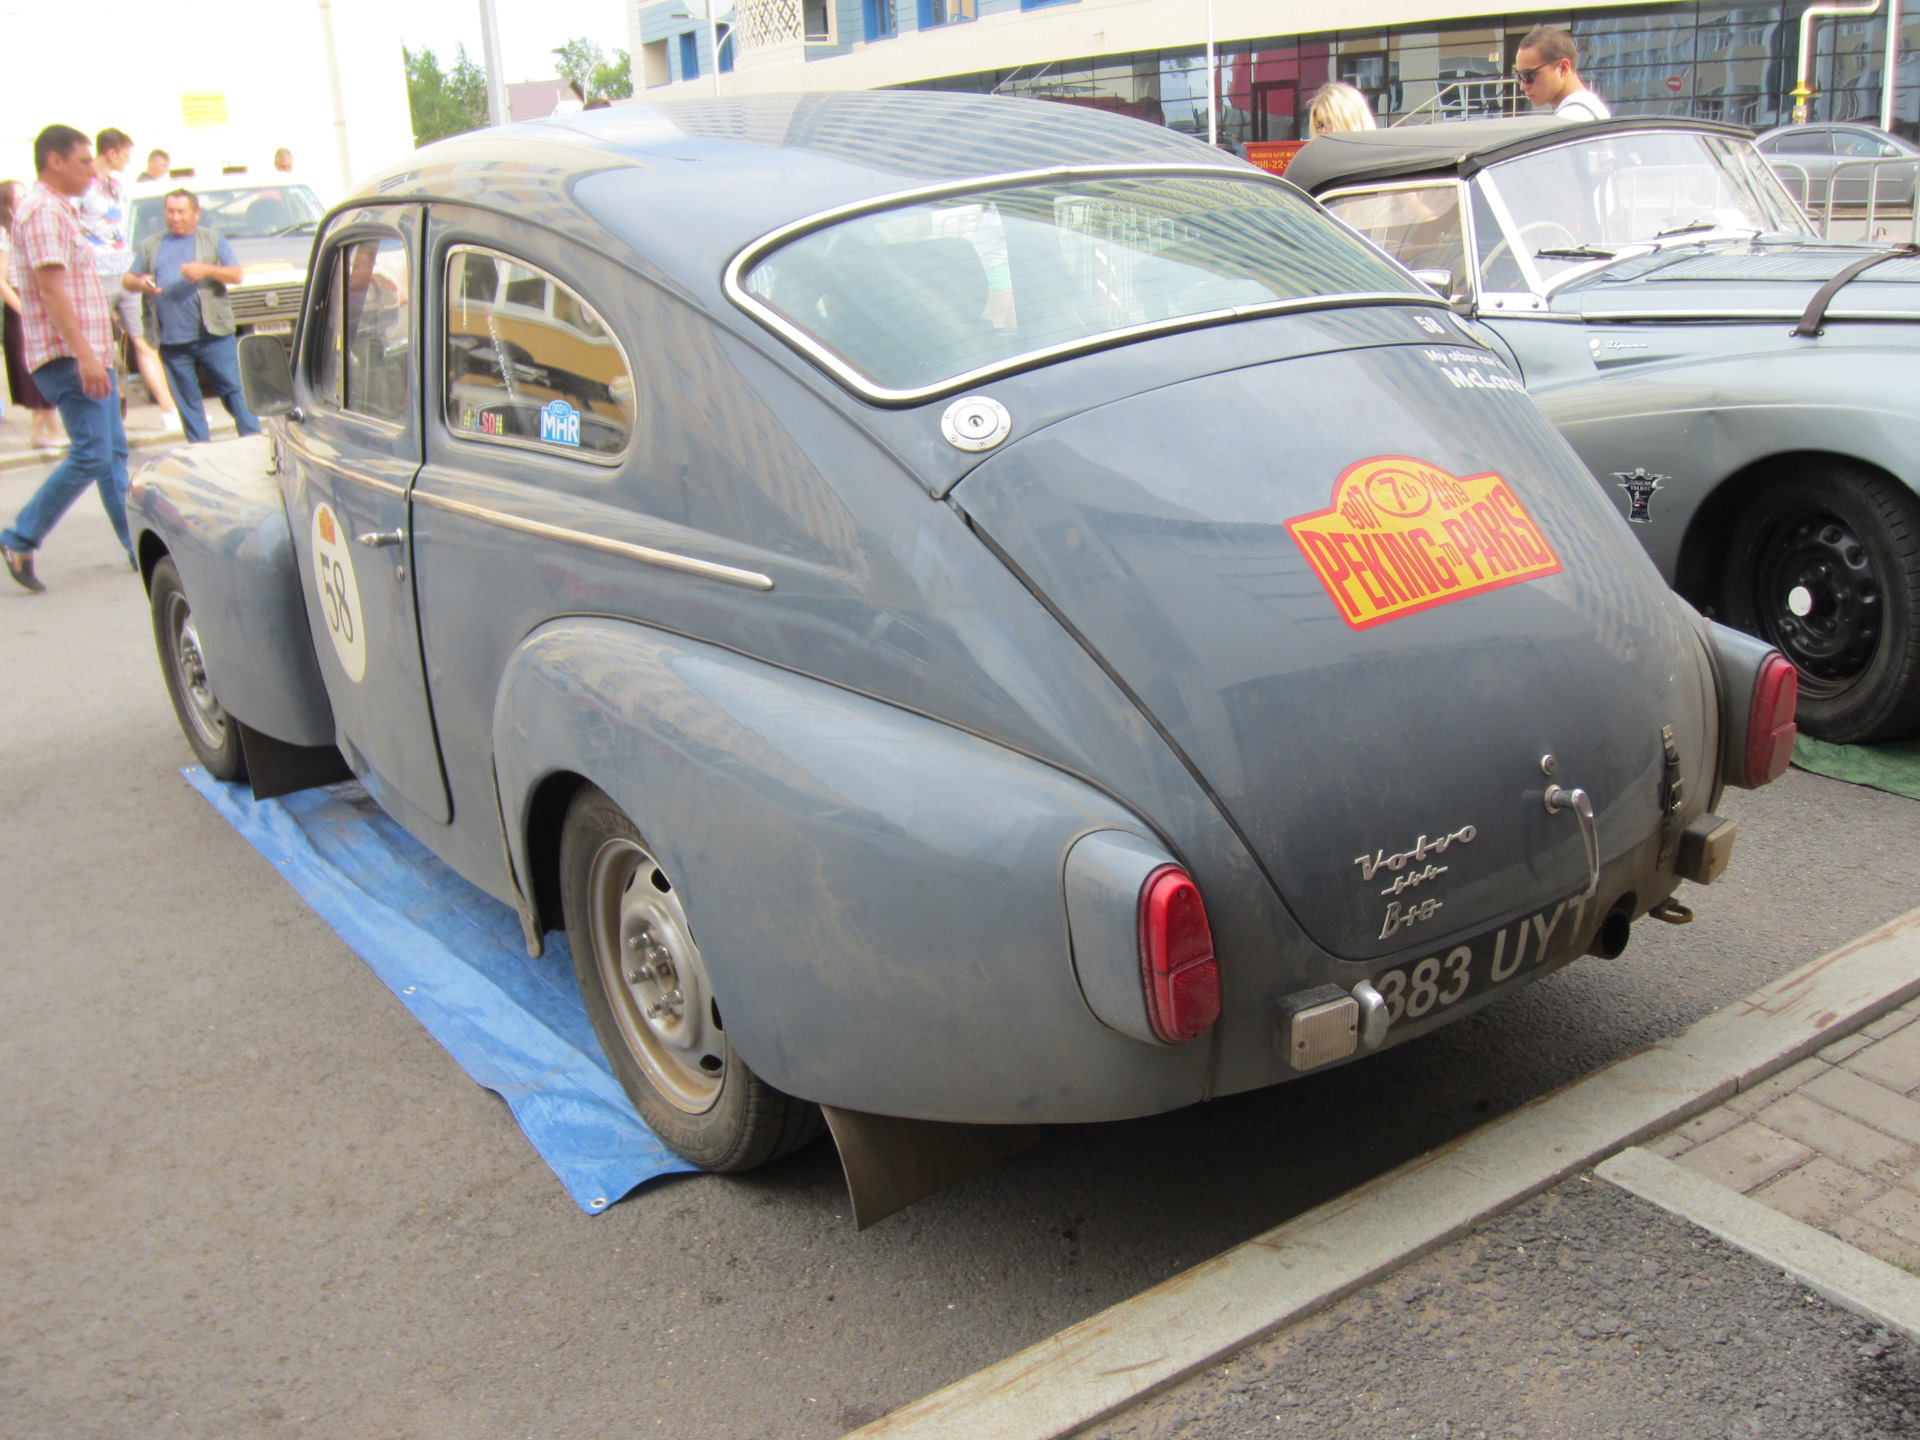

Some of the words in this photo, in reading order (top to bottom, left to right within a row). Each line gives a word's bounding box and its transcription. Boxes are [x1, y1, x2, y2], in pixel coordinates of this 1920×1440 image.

[1413, 315, 1446, 334] 58
[1440, 366, 1527, 395] McLare
[543, 411, 579, 443] MHR
[1340, 485, 1382, 530] 1907
[1418, 469, 1470, 511] 2019
[1300, 527, 1462, 617] PEKING
[1441, 484, 1551, 580] PARIS
[320, 551, 354, 644] 58
[1376, 945, 1472, 1027] 383
[1490, 893, 1597, 983] UYT
